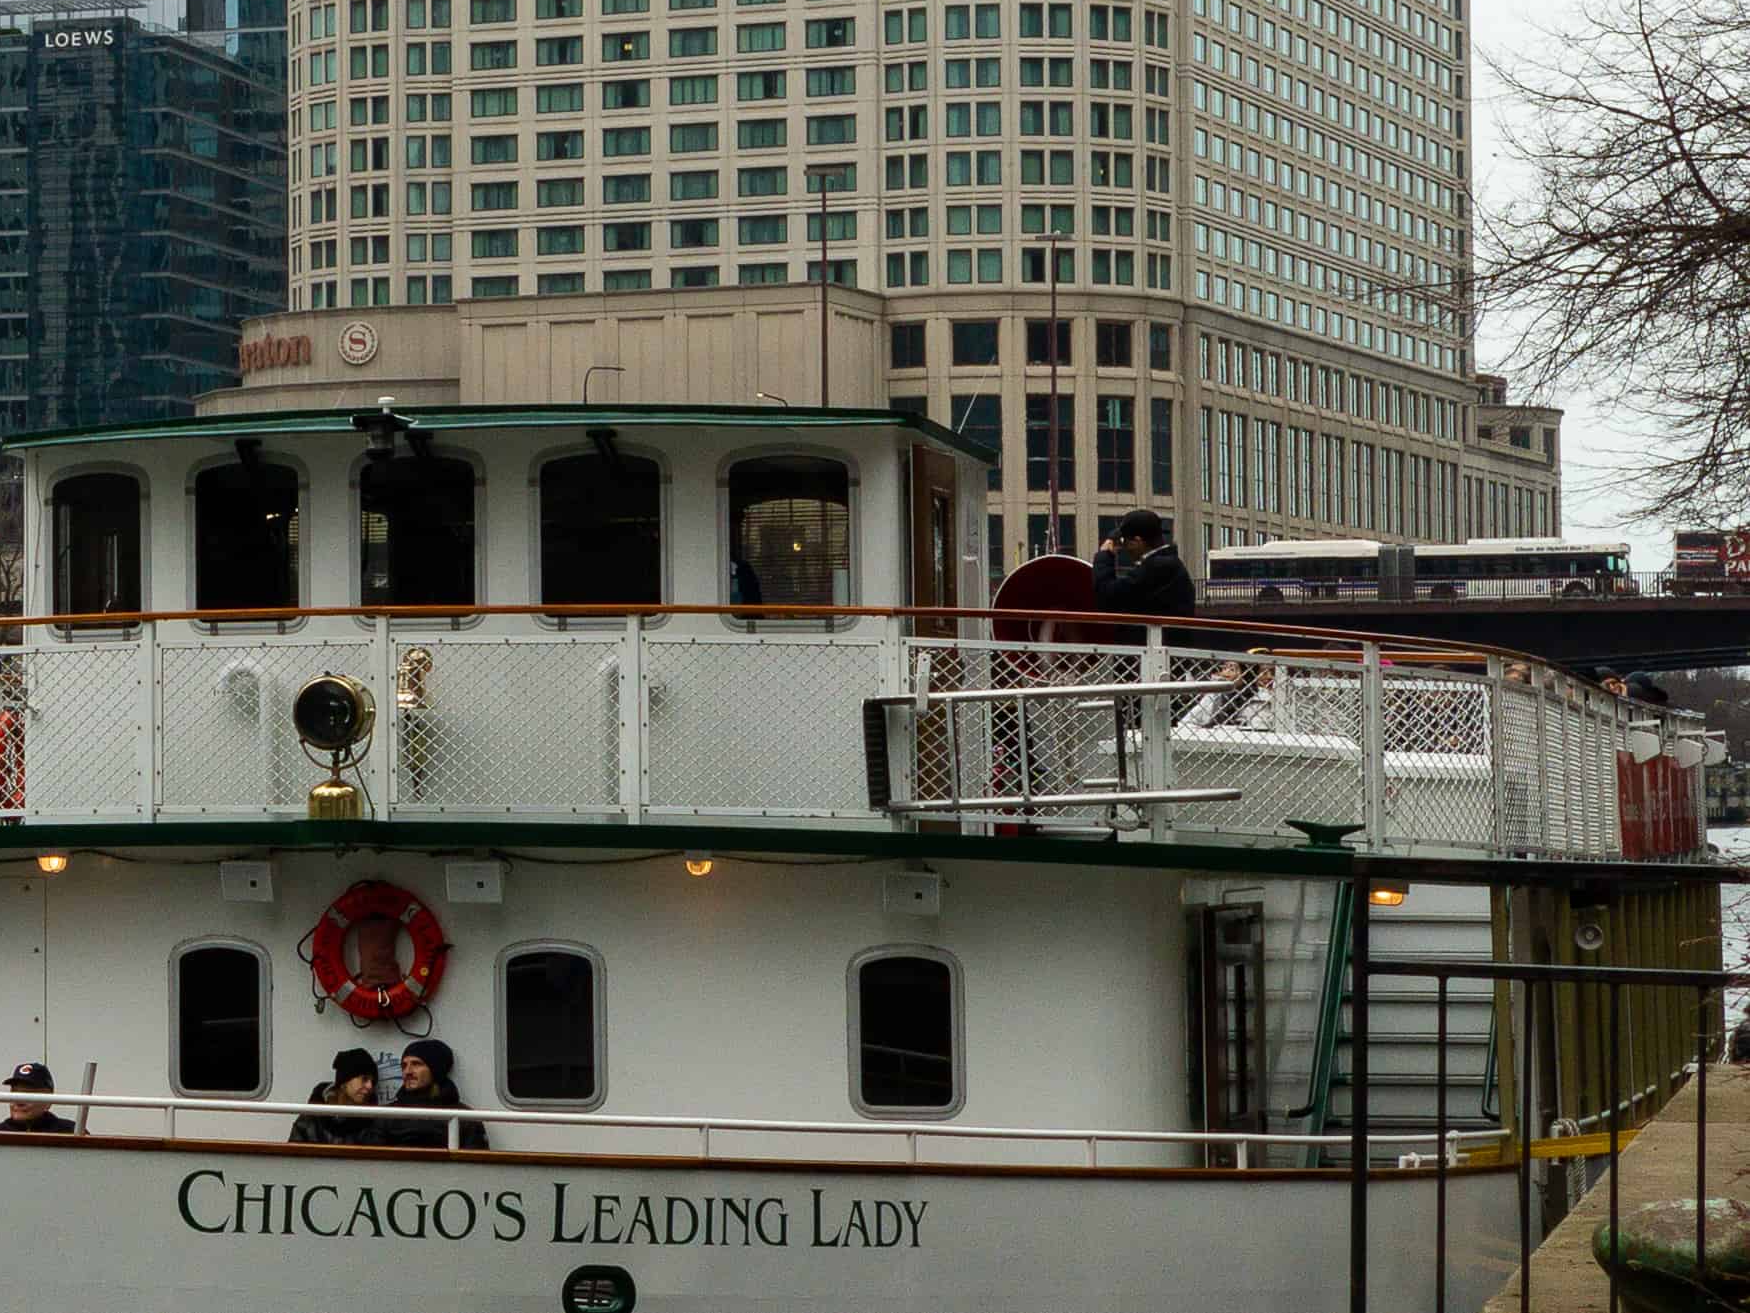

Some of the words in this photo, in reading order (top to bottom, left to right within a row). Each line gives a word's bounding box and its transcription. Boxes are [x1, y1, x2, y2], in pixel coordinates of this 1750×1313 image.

[45, 29, 114, 48] LOEWS
[1724, 560, 1750, 577] PA
[177, 1169, 526, 1242] CHICAGO'S
[550, 1182, 789, 1247] LEADING
[809, 1189, 929, 1248] LADY
